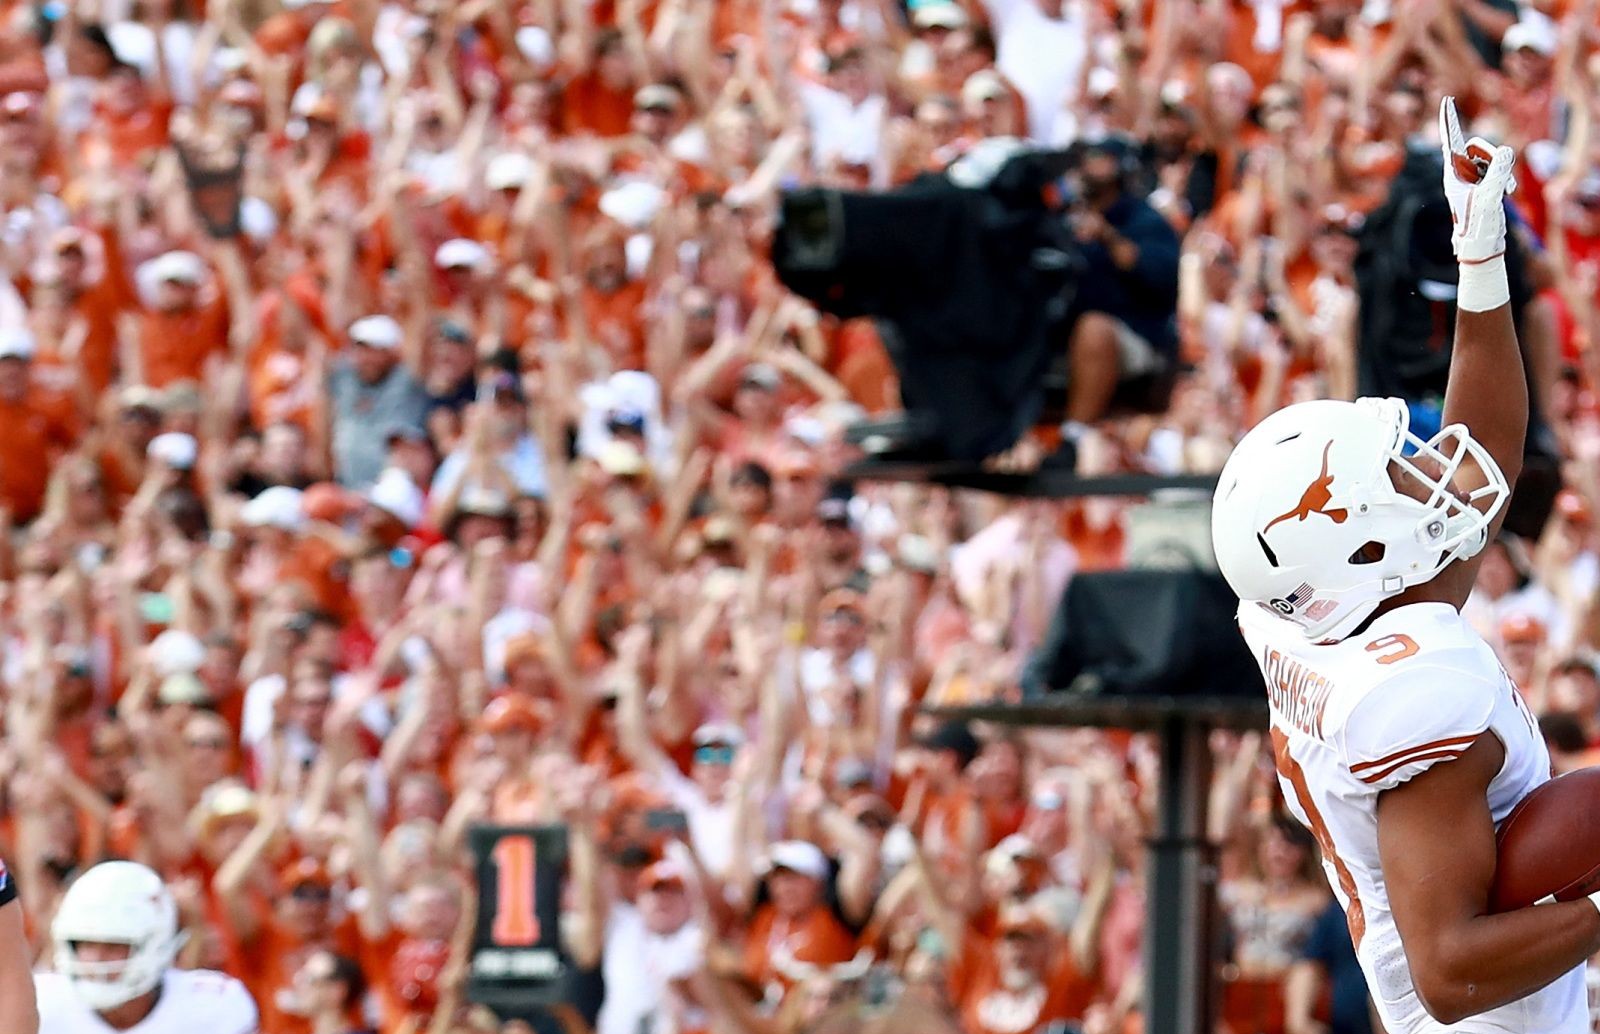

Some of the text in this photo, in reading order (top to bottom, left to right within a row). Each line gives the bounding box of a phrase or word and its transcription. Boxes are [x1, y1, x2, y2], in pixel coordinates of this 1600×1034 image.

[1264, 644, 1335, 742] JOHNSON
[1364, 633, 1420, 664] 9
[491, 834, 541, 947] 1
